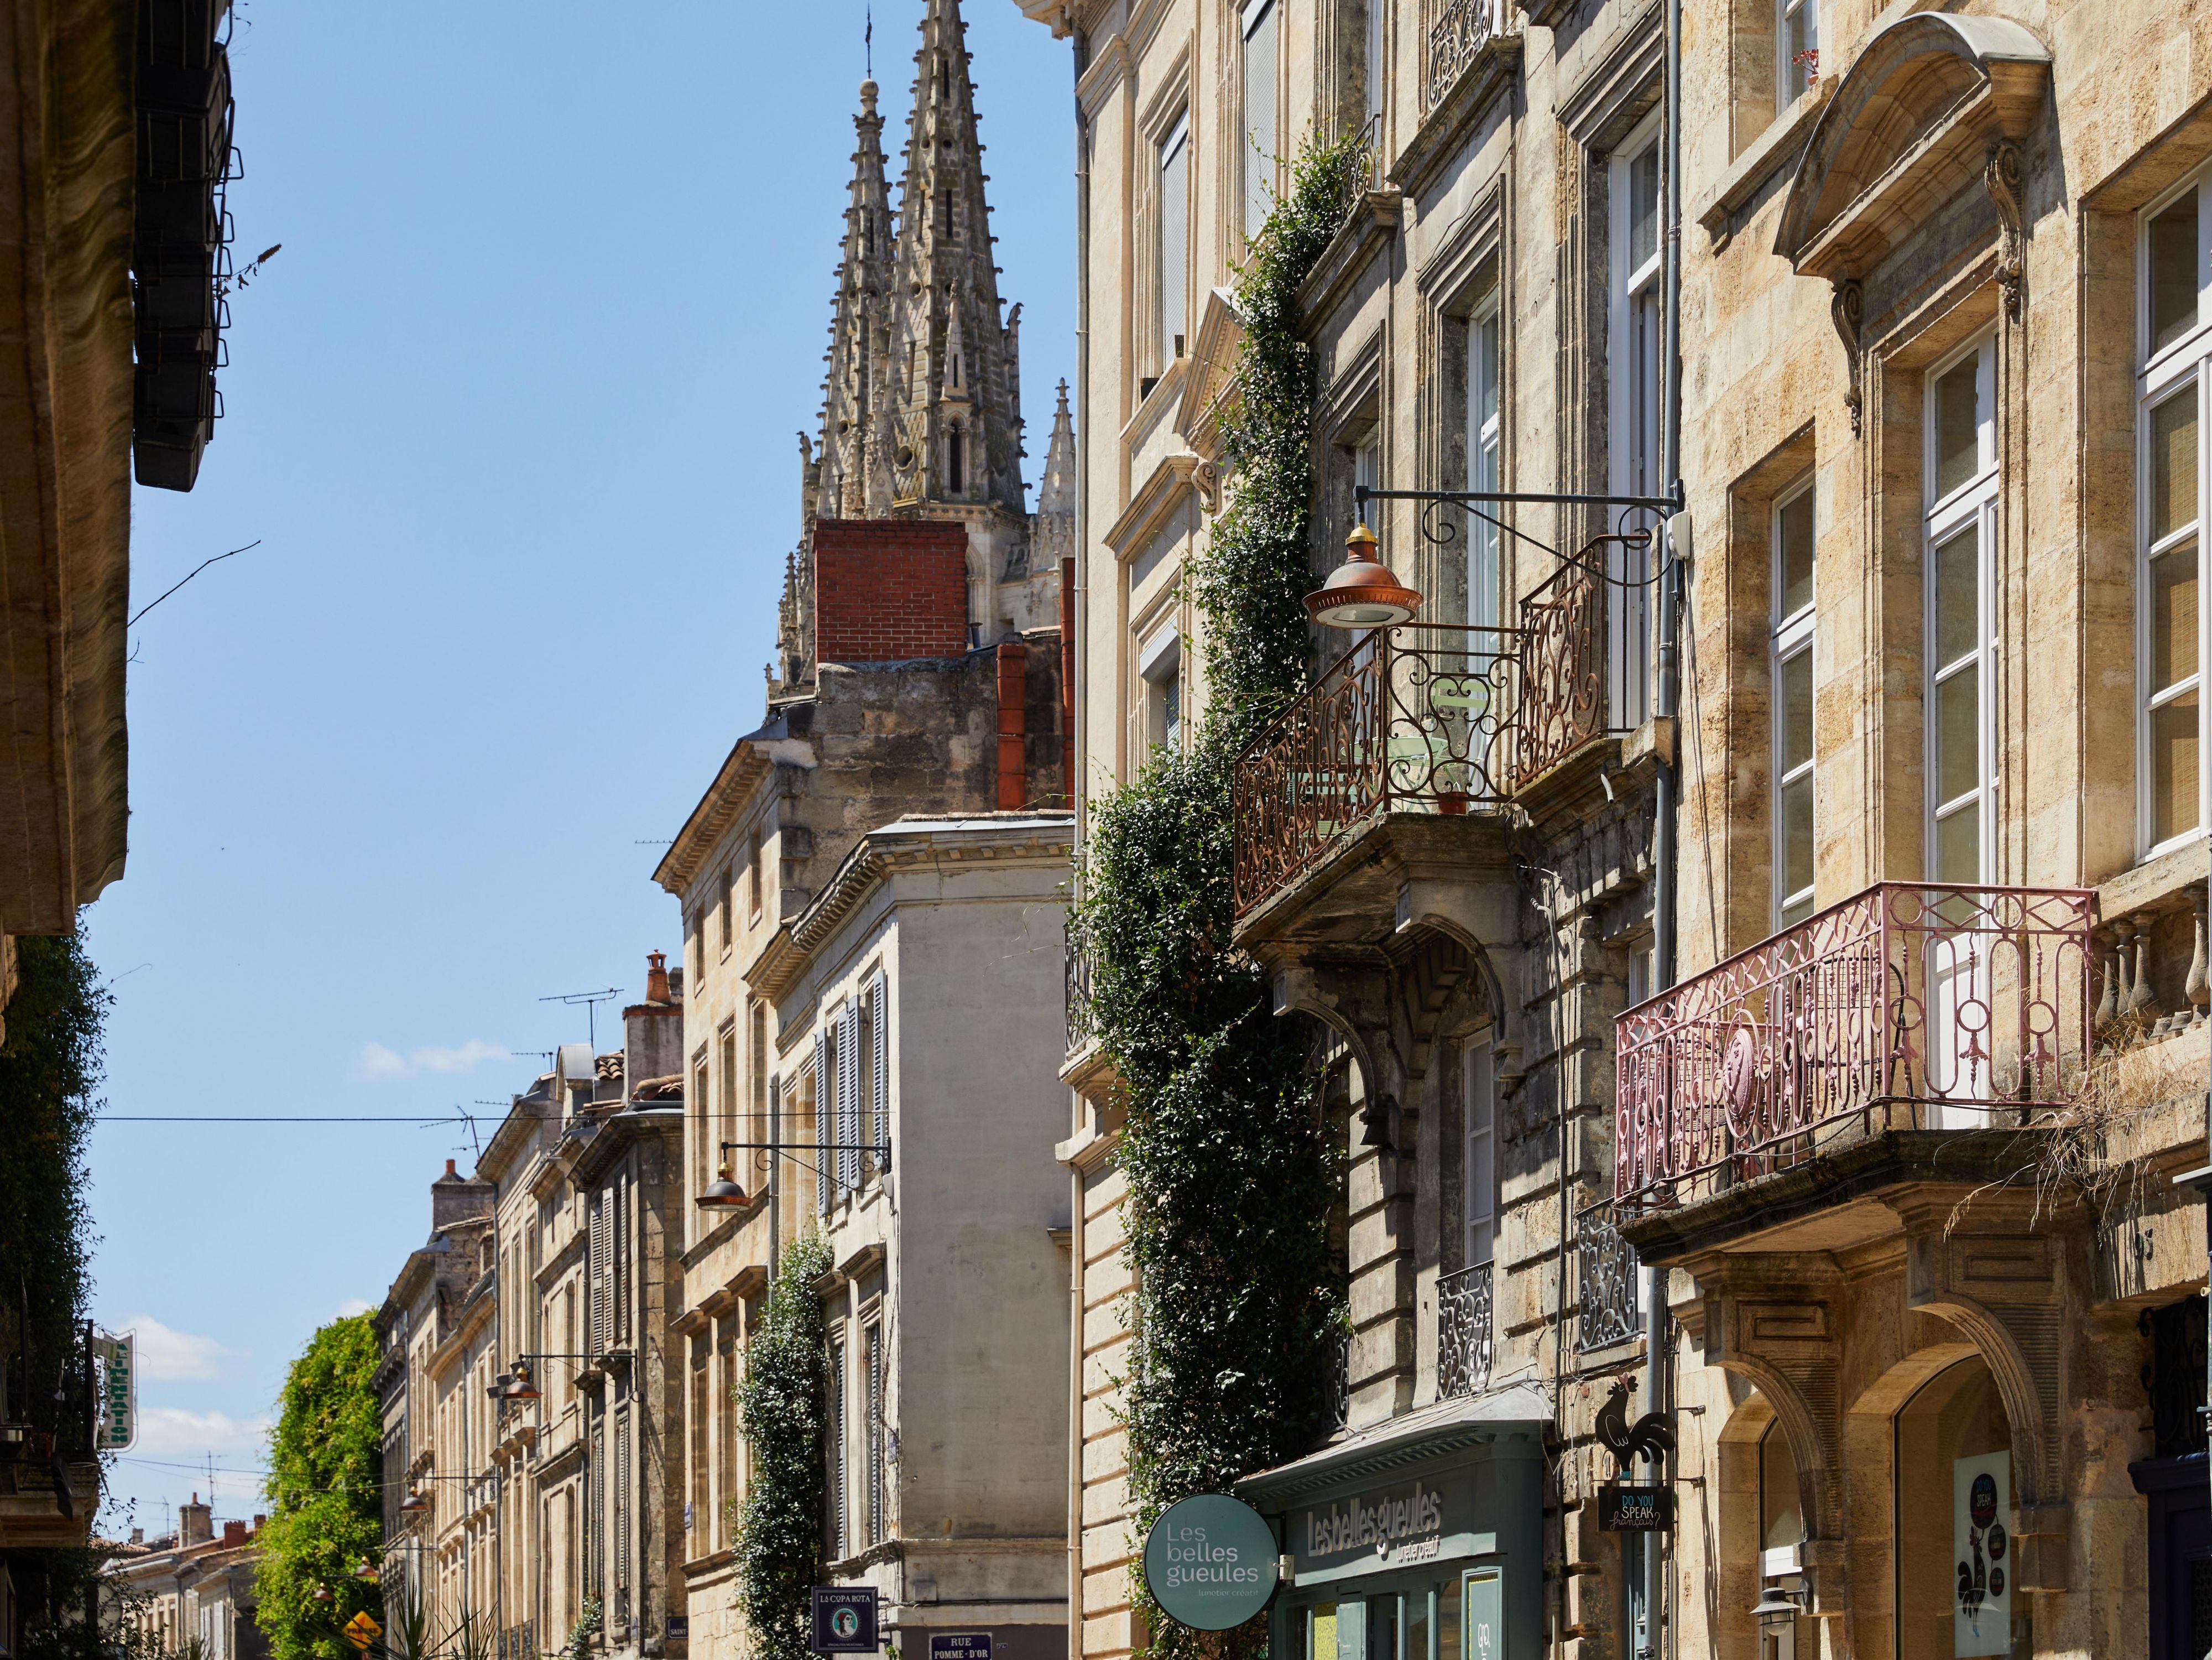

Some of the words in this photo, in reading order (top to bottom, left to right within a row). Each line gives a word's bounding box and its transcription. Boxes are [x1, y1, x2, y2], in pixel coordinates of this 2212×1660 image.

[111, 1343, 128, 1442] ALIMENTATION
[1622, 1495, 1634, 1506] DO
[1637, 1495, 1653, 1507] YOU
[1977, 1493, 1991, 1507] SPEAK
[1308, 1512, 1333, 1557] Les
[1332, 1497, 1378, 1551] belles
[1376, 1482, 1441, 1555] gueules
[1621, 1506, 1653, 1518] SPEAK
[1167, 1523, 1206, 1542] Les
[1167, 1542, 1238, 1562] belles
[1167, 1563, 1259, 1588] gueules
[951, 1638, 972, 1646] RUE
